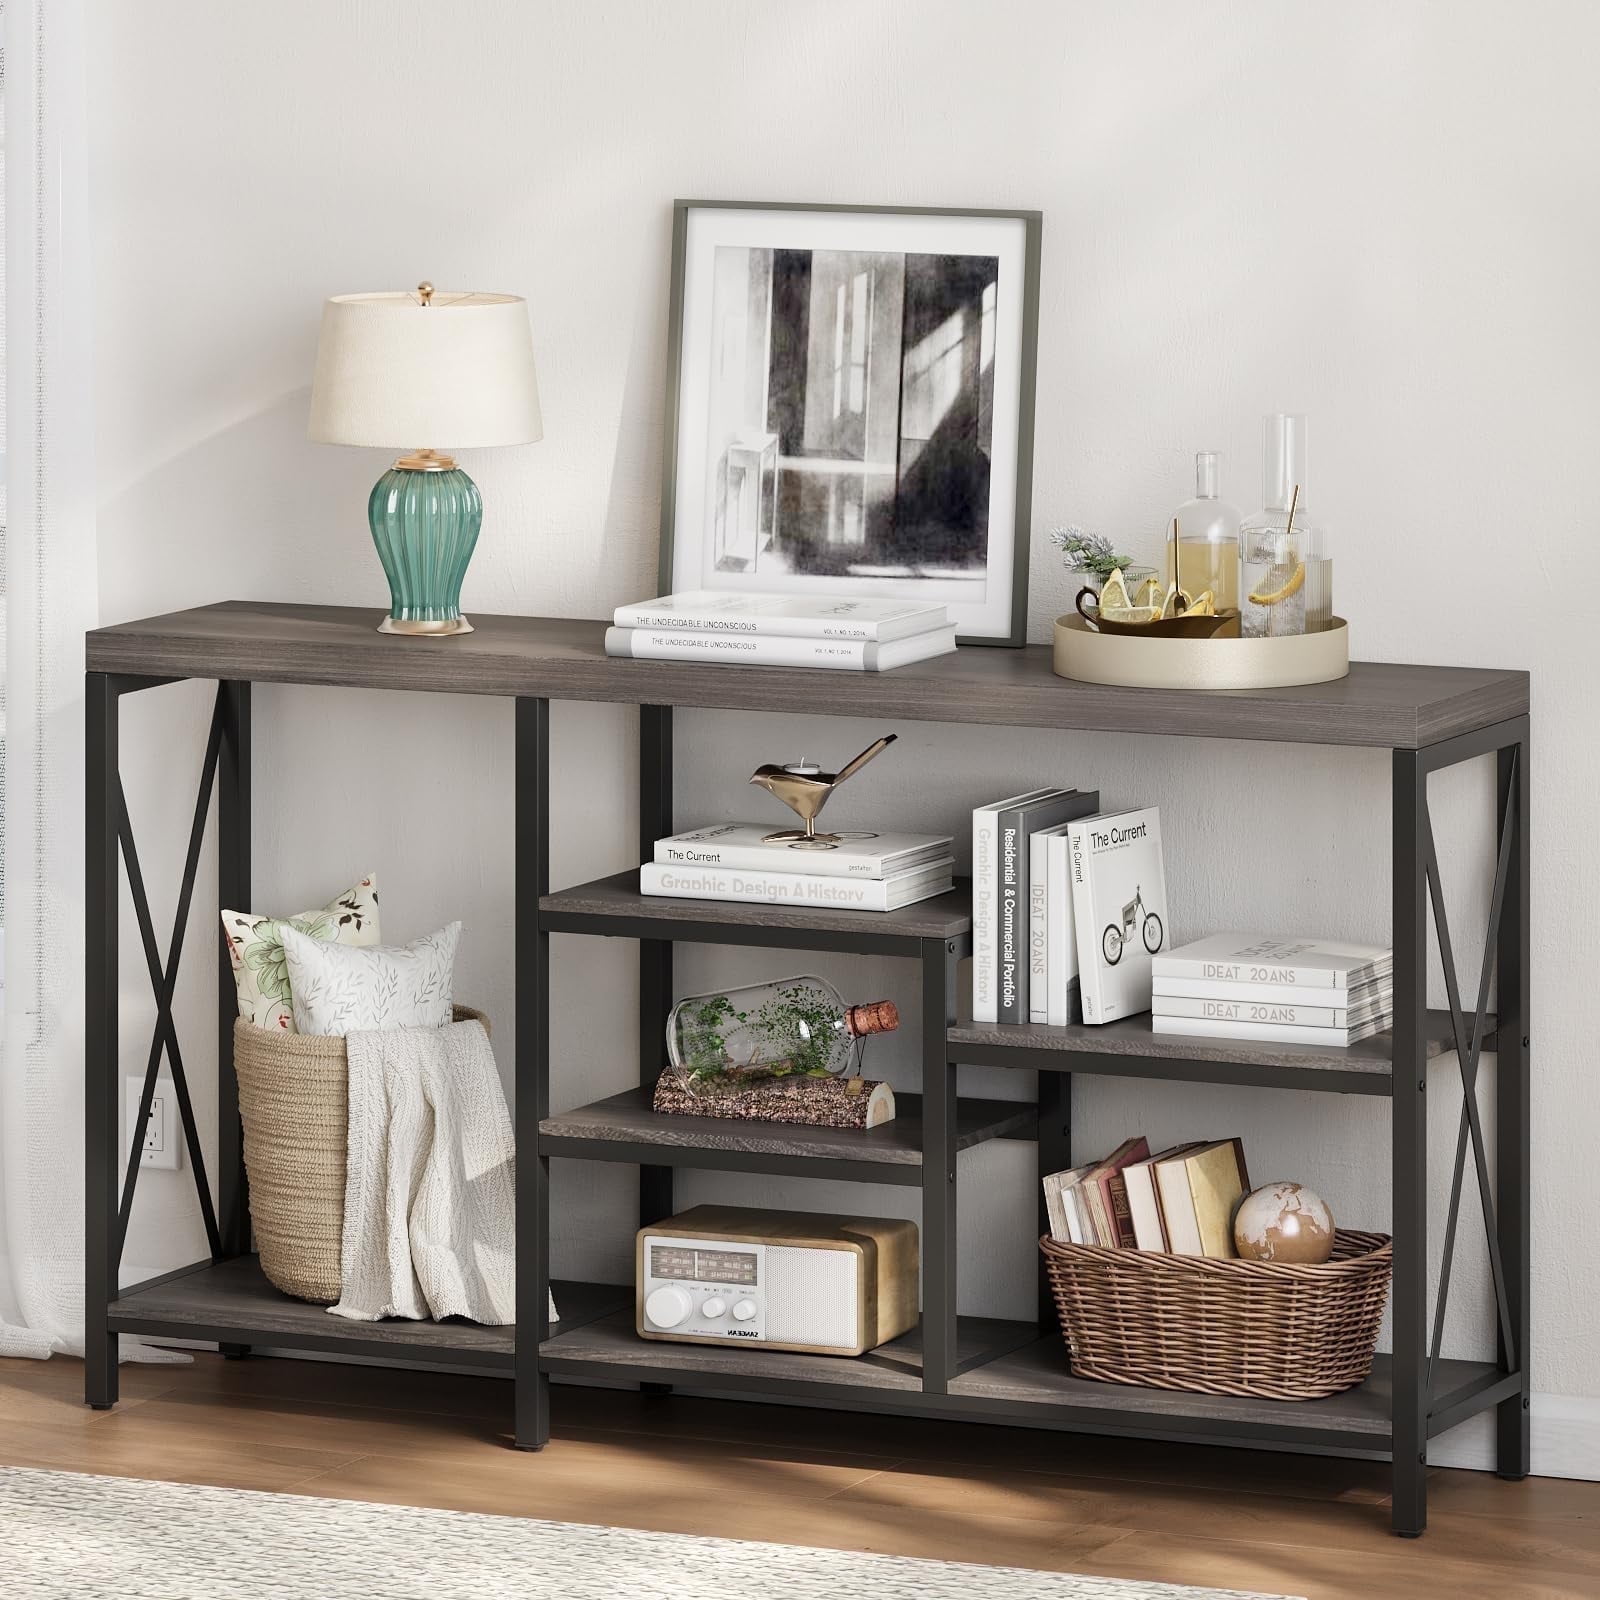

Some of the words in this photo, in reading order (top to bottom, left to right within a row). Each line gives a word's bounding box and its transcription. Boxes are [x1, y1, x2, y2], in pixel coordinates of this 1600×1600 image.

[637, 616, 650, 625] THE
[652, 618, 701, 628] UNDECIDABLE
[703, 620, 757, 631] UNCONSCIOUS
[652, 637, 664, 645] THE
[666, 639, 709, 648] UNDECIDABLE
[710, 641, 757, 650] UNCONSCIOUS
[1073, 835, 1081, 851] The
[1090, 832, 1109, 849] The
[1110, 821, 1147, 844] Current
[667, 849, 684, 860] The
[686, 850, 721, 862] Current
[1004, 828, 1016, 885] Residential
[1074, 852, 1083, 883] Current
[660, 873, 726, 892] Graphic
[732, 878, 788, 902] Design
[793, 882, 804, 897] A
[807, 883, 864, 901] History
[1004, 889, 1015, 897] &
[1032, 884, 1045, 921] IDEAT
[1004, 899, 1016, 962] Commercial
[1203, 964, 1240, 980] IDEAT
[1003, 963, 1015, 1007] Portfolio
[1203, 1003, 1240, 1018] IDEAT
